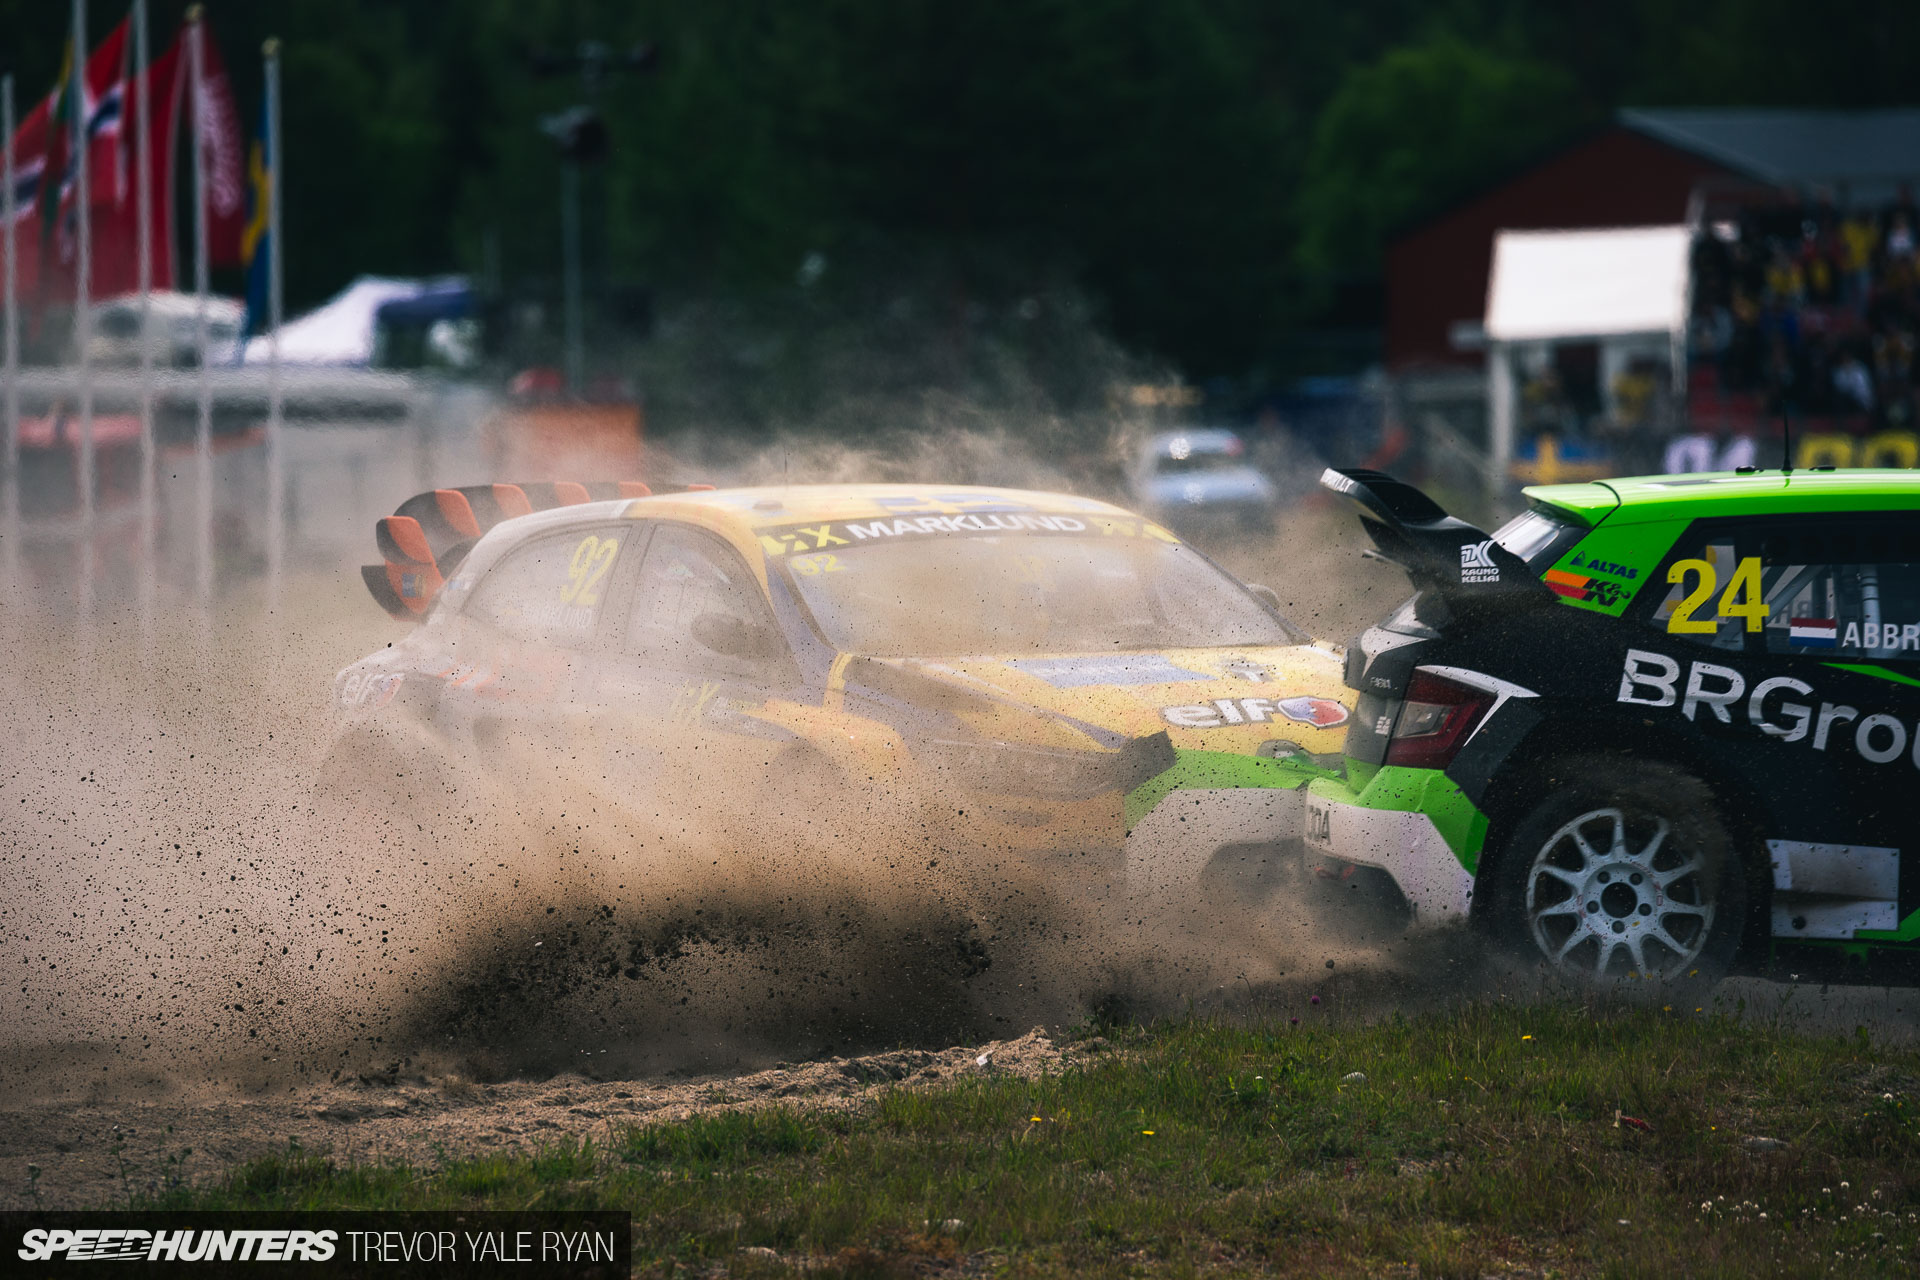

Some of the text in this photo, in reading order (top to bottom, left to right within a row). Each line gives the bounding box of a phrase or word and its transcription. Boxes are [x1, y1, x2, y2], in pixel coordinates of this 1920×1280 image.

[845, 513, 1086, 540] MARKLUND
[560, 535, 619, 606] 92
[791, 554, 846, 577] 92
[1461, 567, 1499, 576] KAUNO
[1461, 575, 1500, 583] KELIAI
[1587, 559, 1639, 580] ALTAS
[1667, 557, 1770, 634] 24
[1841, 622, 1920, 651] ABBR
[1616, 648, 1920, 772] BRGro
